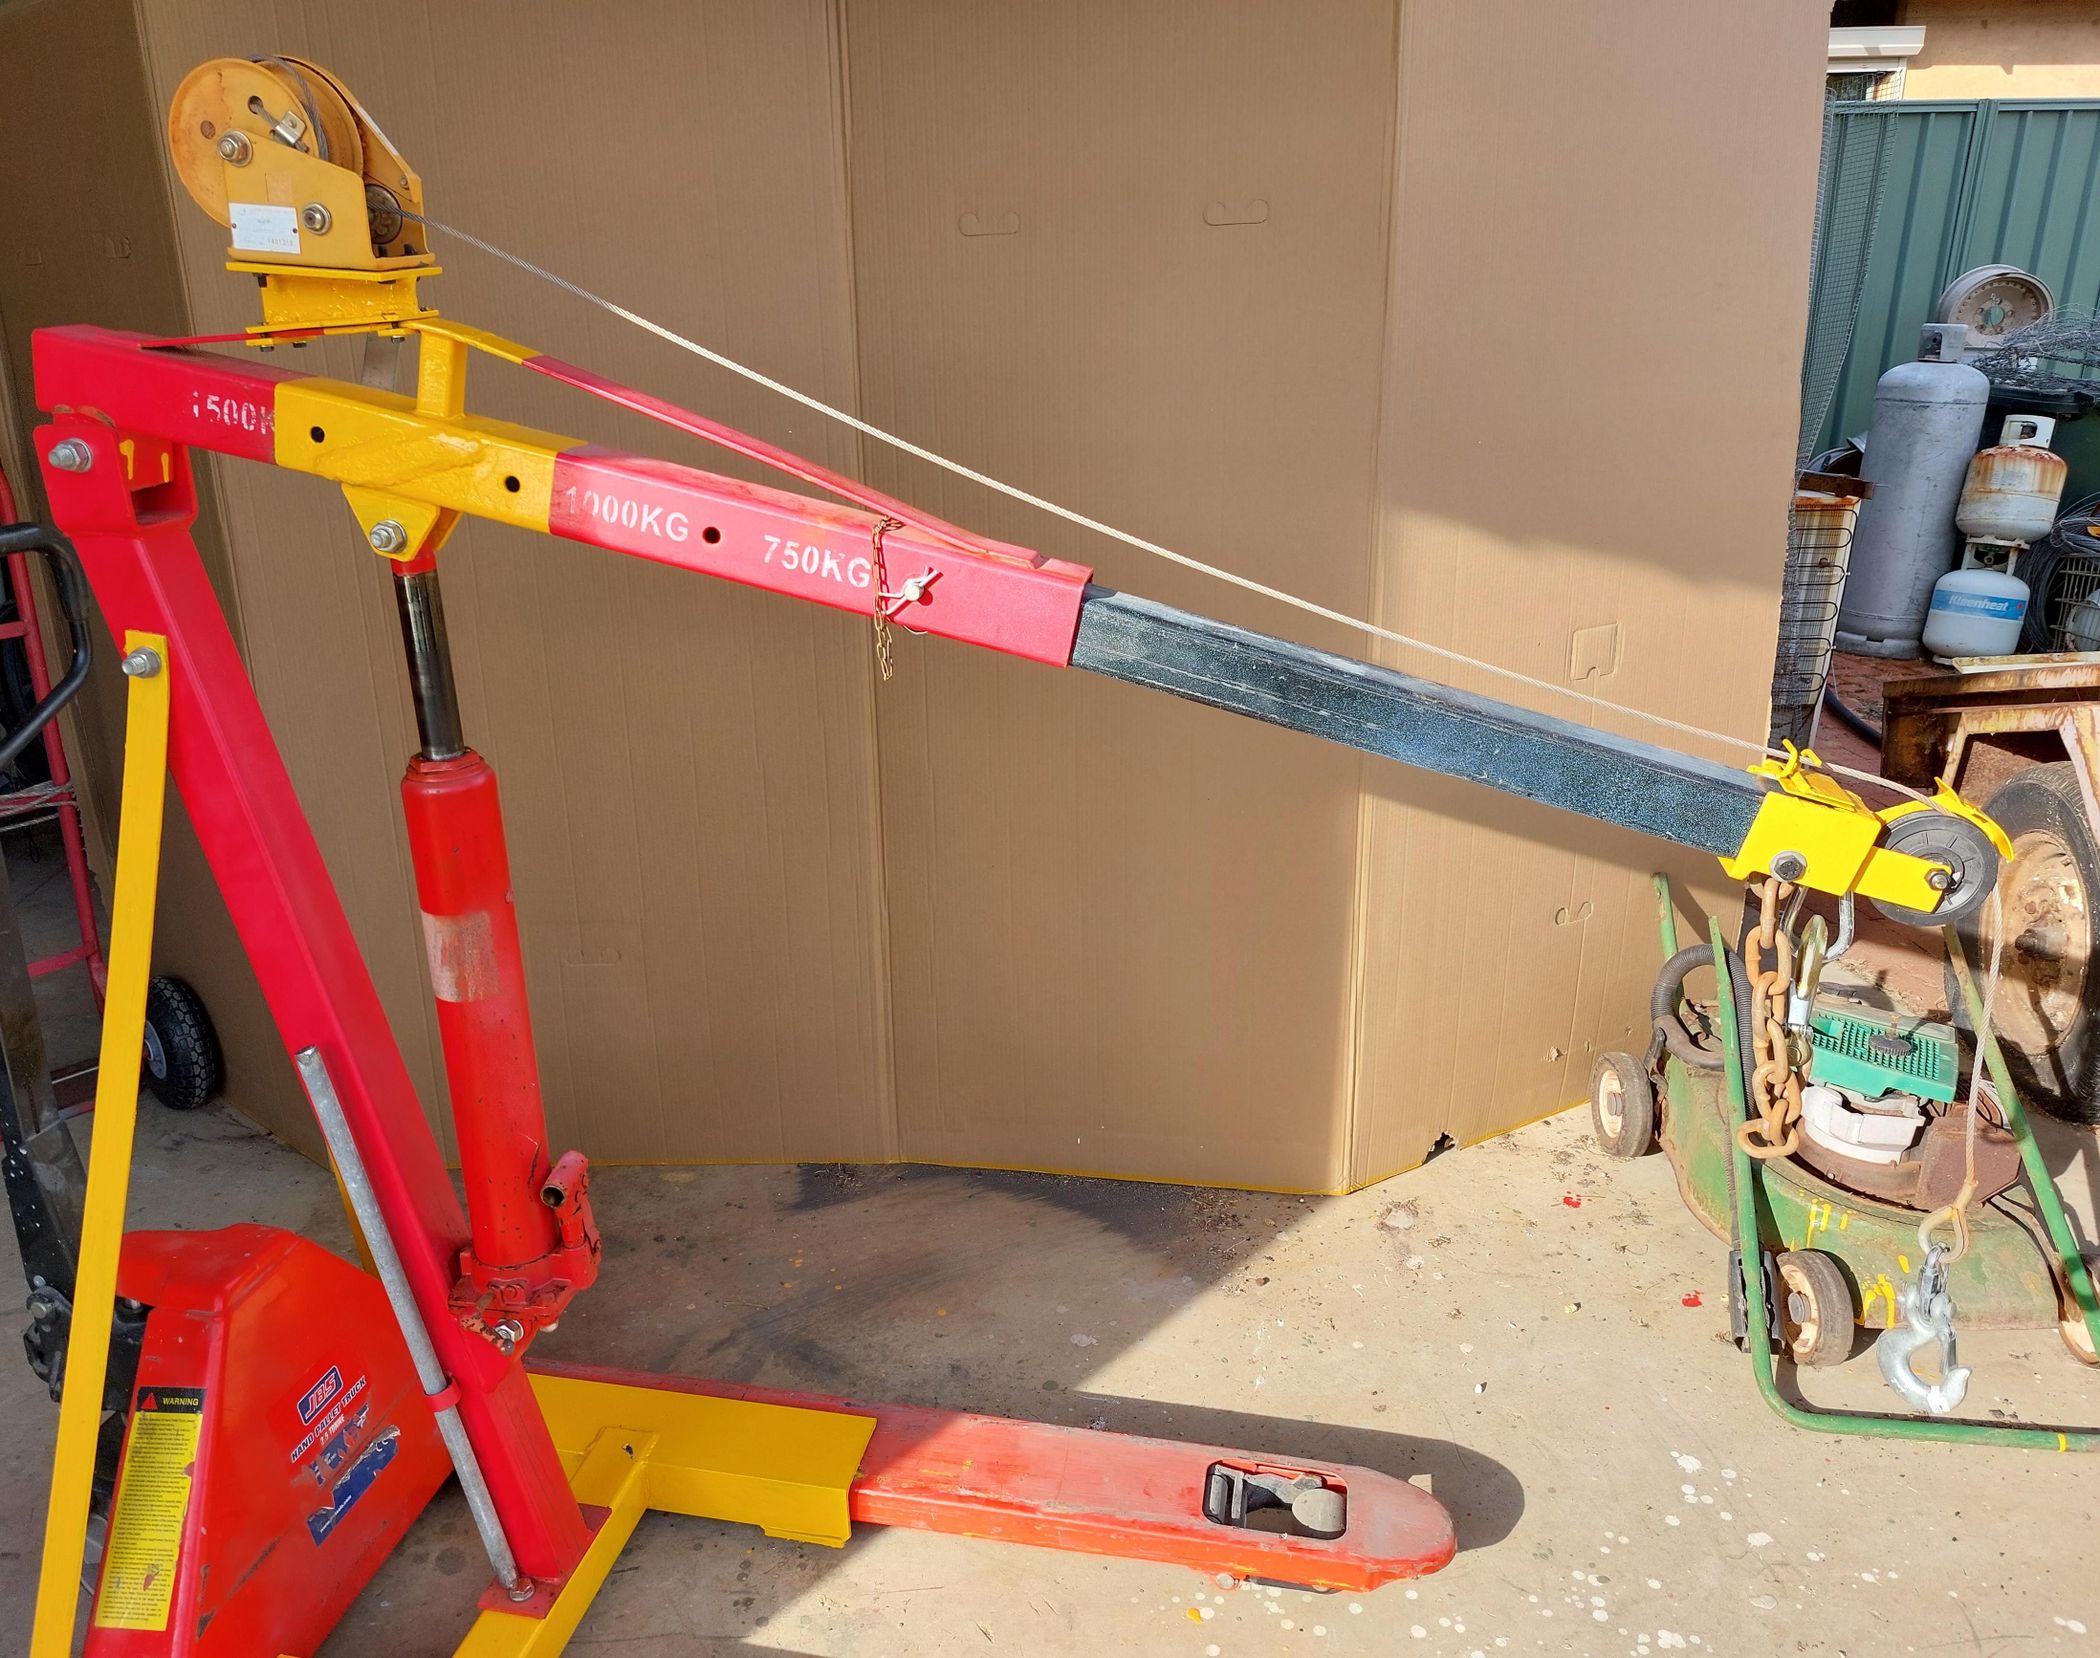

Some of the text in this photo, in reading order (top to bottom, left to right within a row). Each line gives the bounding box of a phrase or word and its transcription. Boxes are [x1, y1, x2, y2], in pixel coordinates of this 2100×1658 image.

[566, 486, 688, 542] 1000KG
[763, 535, 871, 588] 750KG
[1949, 594, 2008, 611] Kleenheat
[163, 1397, 199, 1406] WARNING
[291, 1432, 314, 1462] HAND
[314, 1402, 341, 1436] PALLET
[341, 1375, 366, 1407] TRUCK
[304, 1372, 338, 1420] JBS
